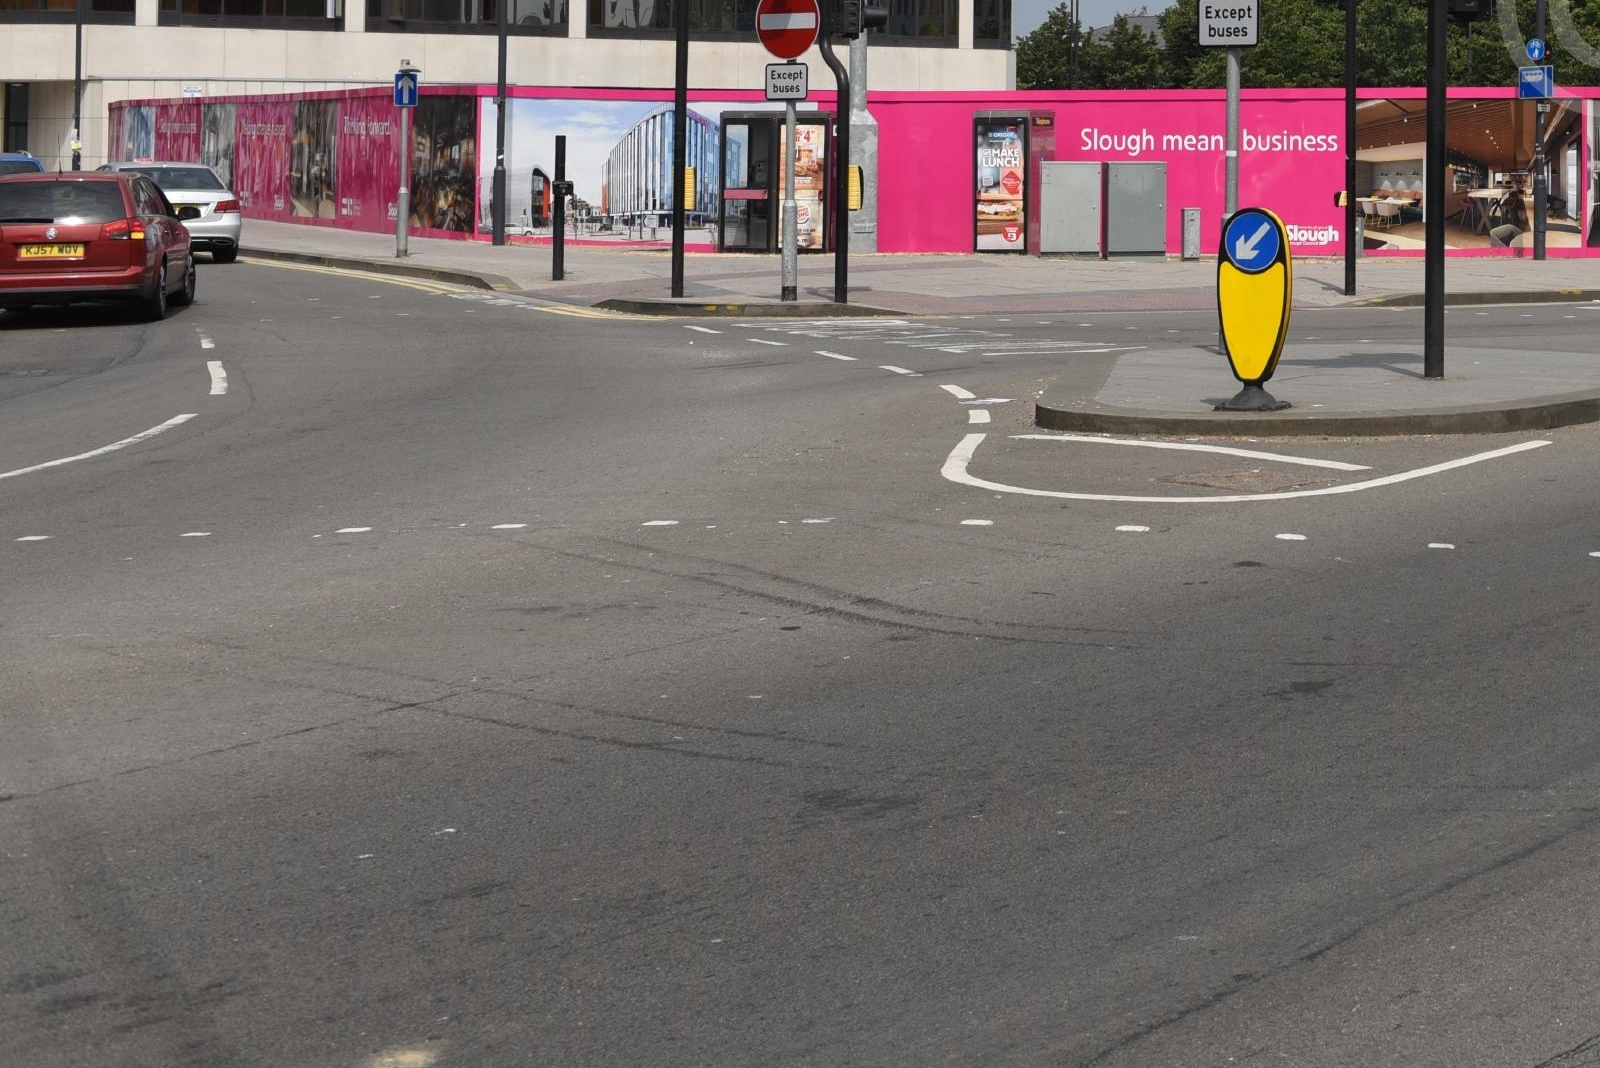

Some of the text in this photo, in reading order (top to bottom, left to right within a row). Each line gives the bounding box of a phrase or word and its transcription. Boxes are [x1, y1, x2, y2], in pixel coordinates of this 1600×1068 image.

[1205, 5, 1253, 21] Except
[1208, 24, 1248, 37] buses
[770, 70, 803, 81] Except
[772, 84, 801, 93] buses
[1080, 128, 1338, 156] Slough mean business
[993, 148, 1020, 157] MAKE
[982, 157, 1020, 167] LUNCH
[1285, 224, 1340, 246] Slough
